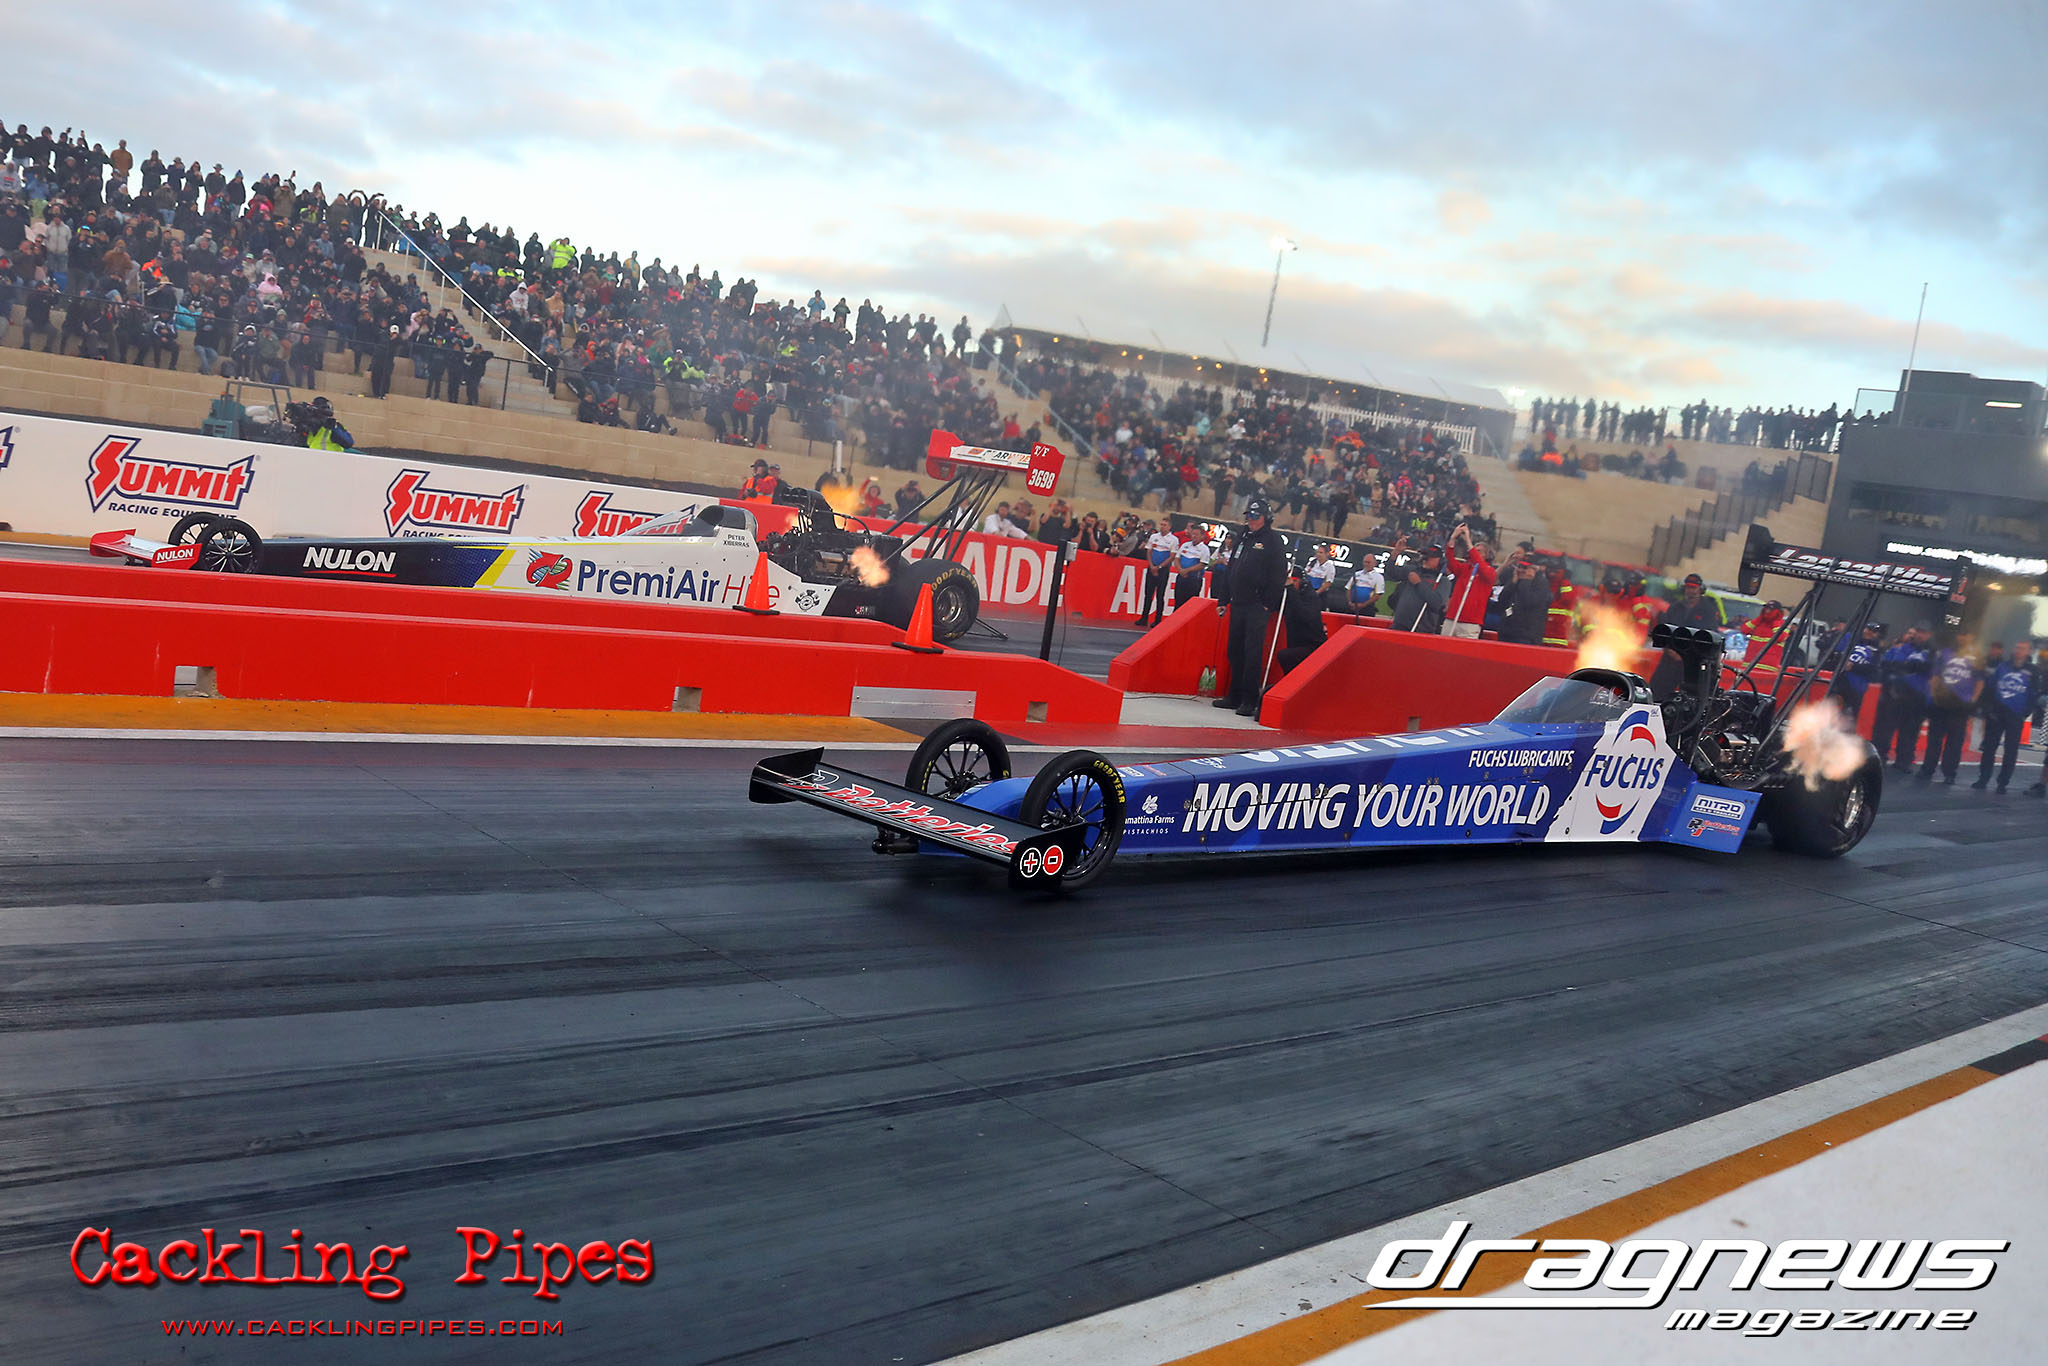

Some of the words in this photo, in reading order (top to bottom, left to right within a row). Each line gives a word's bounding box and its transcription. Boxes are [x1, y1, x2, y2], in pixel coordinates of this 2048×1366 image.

[1033, 445, 1050, 457] T/F
[1027, 468, 1056, 490] 3698
[109, 502, 159, 515] RACING
[156, 548, 194, 562] NULON
[303, 546, 396, 574] NULON
[577, 560, 721, 603] PremiAir
[1820, 573, 1884, 591] FAVOURITE
[1884, 585, 1941, 600] CARROTS
[1467, 751, 1506, 769] FUCHS
[1506, 749, 1575, 768] LUBRICANTS
[1093, 760, 1127, 804] GOODYEAR
[1585, 754, 1665, 791] FUCHS
[1182, 783, 1351, 834] MOVING
[1352, 784, 1444, 828] YOUR
[1444, 783, 1550, 827] WORLD
[1698, 798, 1741, 813] NITRO
[1154, 815, 1175, 824] Farms
